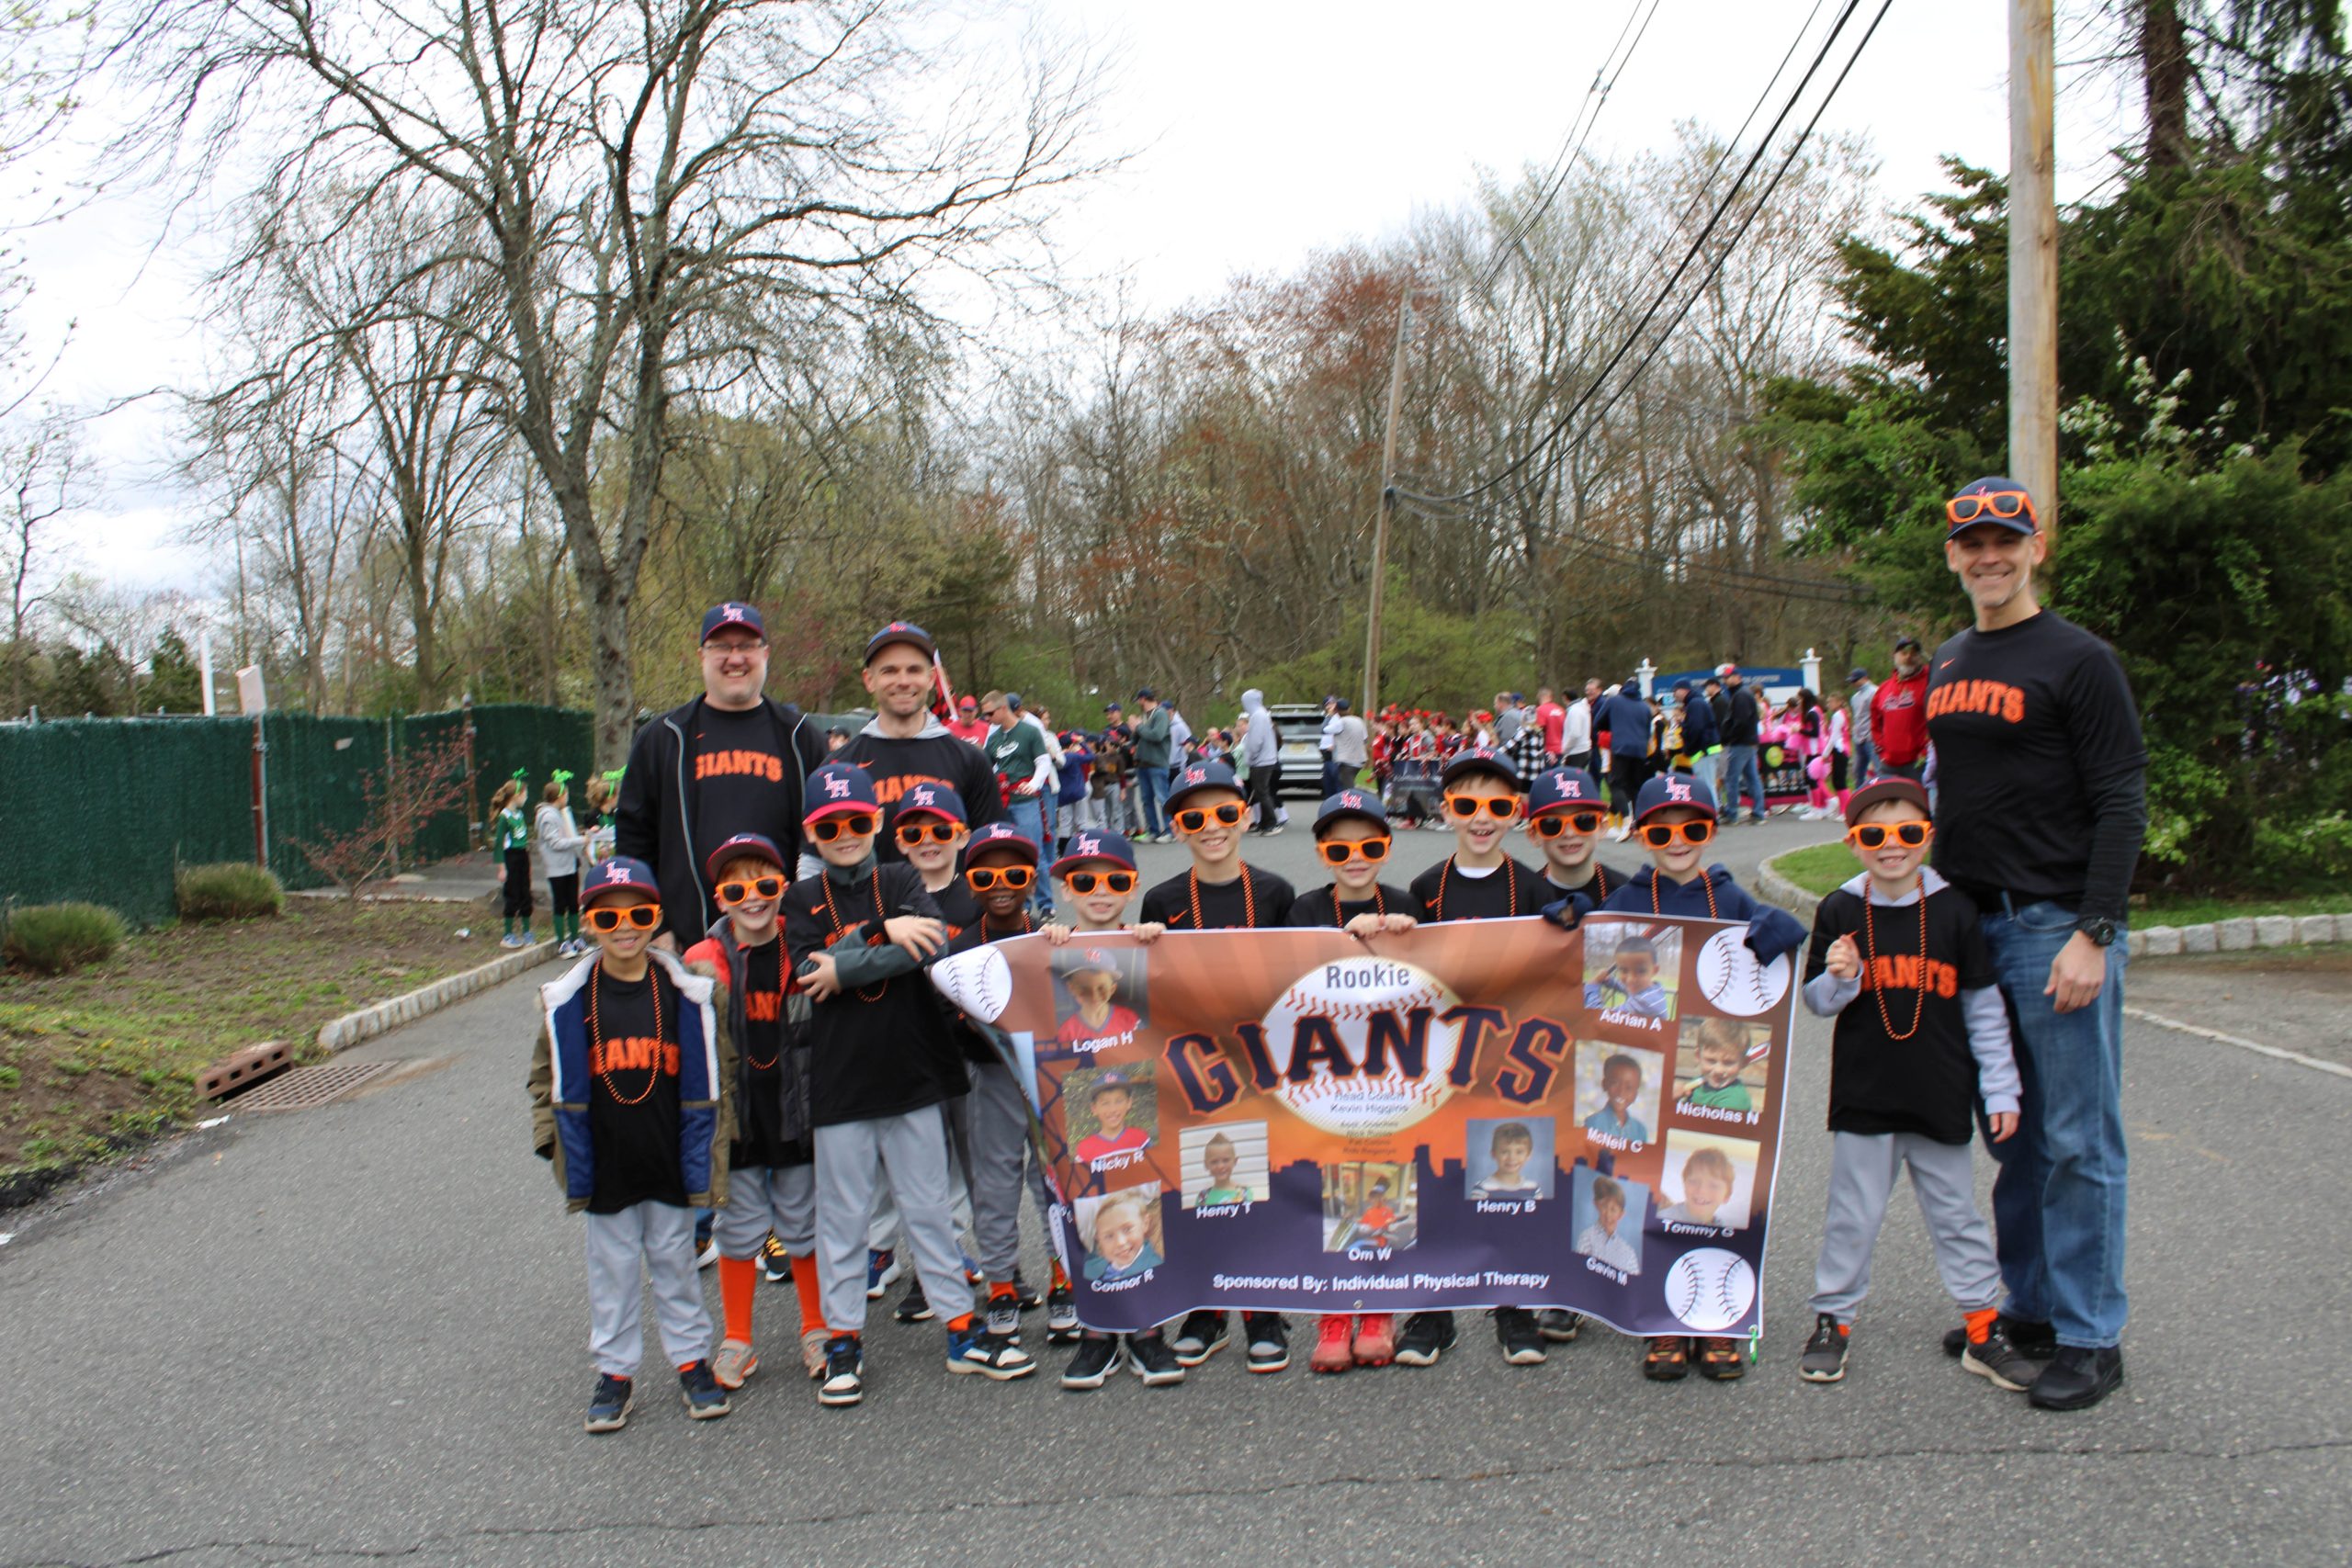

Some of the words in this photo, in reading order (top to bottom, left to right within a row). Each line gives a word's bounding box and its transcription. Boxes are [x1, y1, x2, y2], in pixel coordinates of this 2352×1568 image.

[1926, 679, 2025, 724] GIANTS
[1326, 964, 1410, 988] Rookie
[1860, 953, 1958, 999] IANTS
[1600, 1010, 1647, 1030] Adrian
[1649, 1017, 1662, 1032] A
[1072, 1035, 1118, 1053] Logan
[1121, 1031, 1134, 1045] H
[588, 1036, 680, 1077] IANTS
[1161, 1003, 1574, 1117] GIANTS
[1329, 1104, 1363, 1113] Kevin
[1365, 1103, 1409, 1115] Higgins
[1676, 1100, 1743, 1122] Nicholas
[1746, 1110, 1759, 1125] N
[1587, 1127, 1627, 1151] McNeil
[1630, 1140, 1644, 1154] C
[1091, 1154, 1130, 1173] Nicky
[1133, 1149, 1145, 1164] R
[1195, 1203, 1239, 1219] Henry
[1241, 1201, 1252, 1214] T
[1476, 1200, 1521, 1214] Henry
[1524, 1200, 1537, 1213] B
[1661, 1219, 1718, 1238] Tommy
[1347, 1247, 1374, 1261] Om
[1376, 1247, 1393, 1261] W
[1091, 1274, 1142, 1292] Connor
[1143, 1268, 1154, 1284] R
[1213, 1273, 1299, 1292] Sponsored
[1302, 1275, 1329, 1294] By:
[1332, 1273, 1409, 1291] Individual
[1412, 1272, 1480, 1292] Physical
[1483, 1271, 1550, 1289] Therapy
